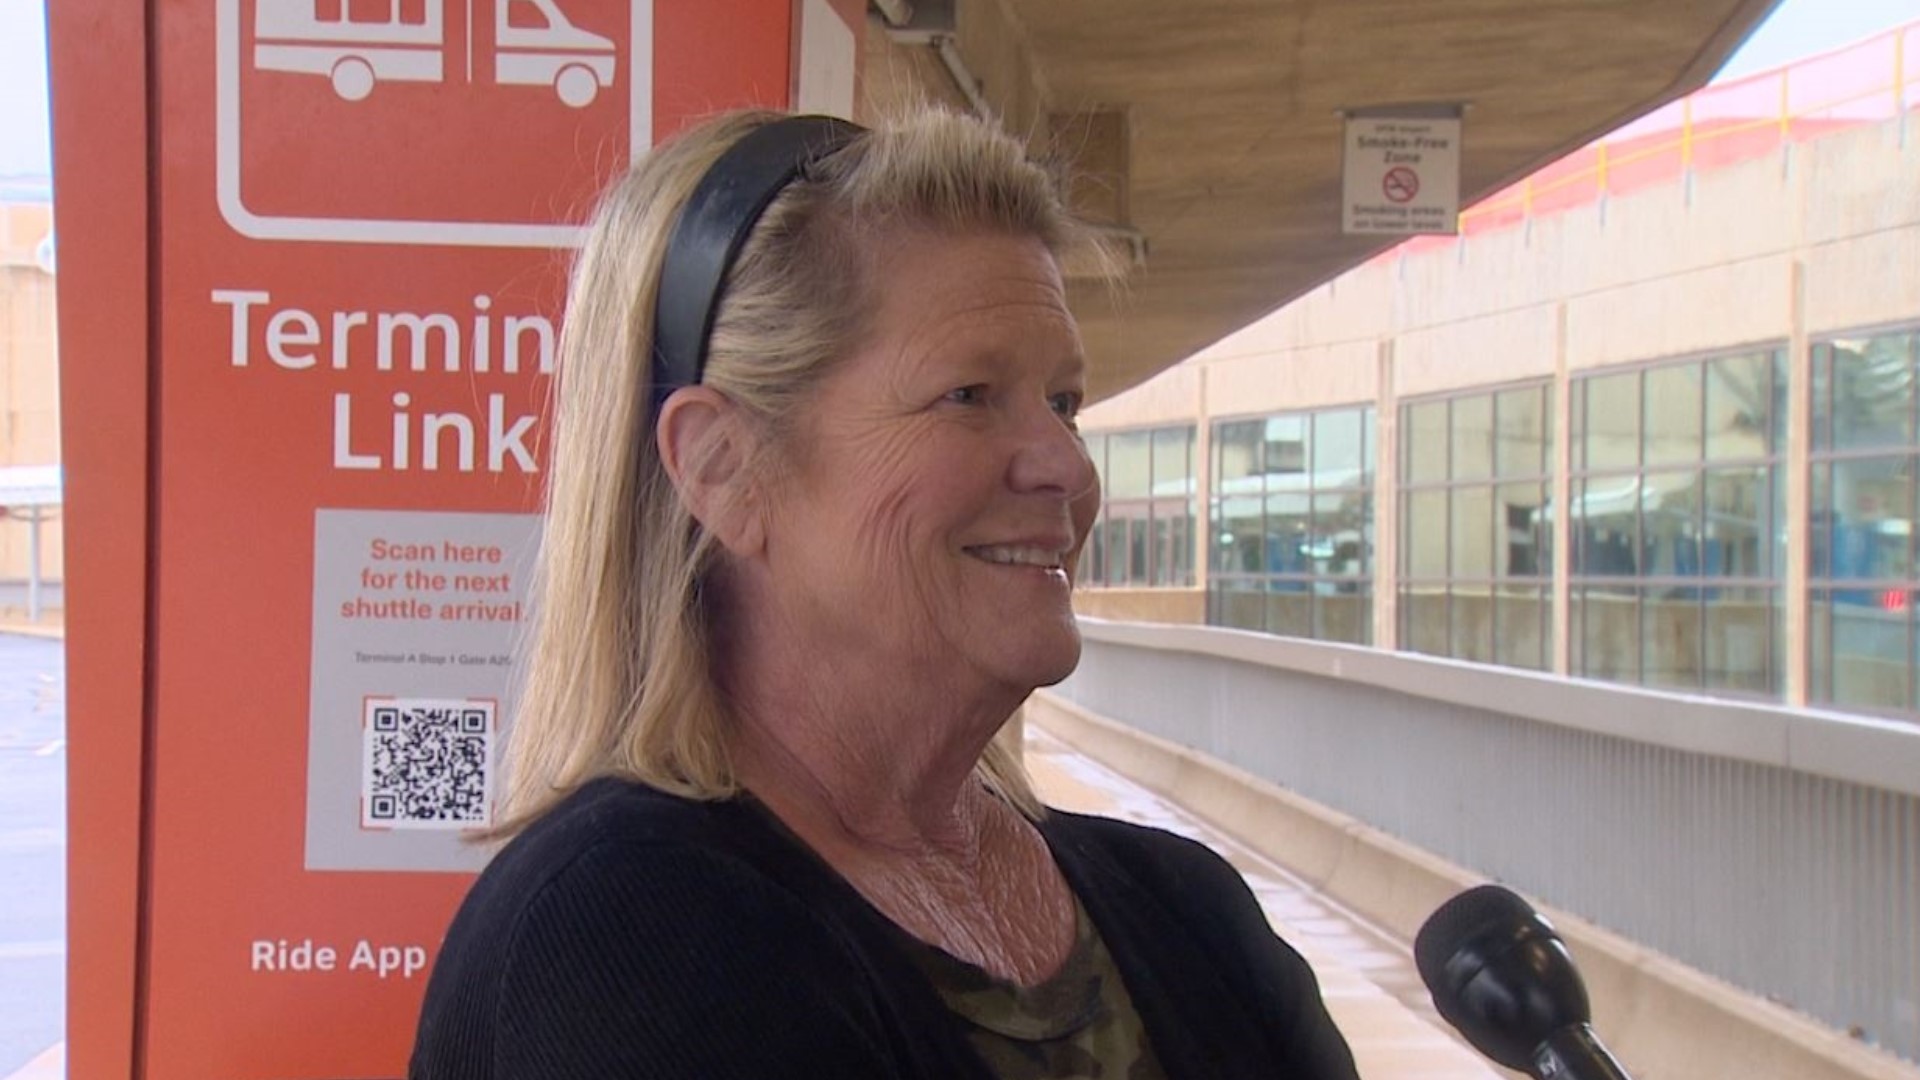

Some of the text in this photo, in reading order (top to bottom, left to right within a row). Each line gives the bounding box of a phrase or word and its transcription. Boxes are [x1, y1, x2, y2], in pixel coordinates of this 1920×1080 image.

[1357, 136, 1449, 149] Smoke-Free
[1383, 150, 1422, 163] Zone
[1353, 204, 1407, 217] Smoking
[210, 289, 556, 374] Termin
[333, 391, 540, 473] Link
[370, 538, 503, 564] Scan here
[361, 567, 510, 593] for the next
[341, 597, 432, 620] shuttle
[355, 651, 405, 664] Terminal
[407, 653, 416, 665] A
[418, 653, 446, 667] Stop
[458, 654, 487, 666] Gate
[252, 938, 426, 979] Ride App
